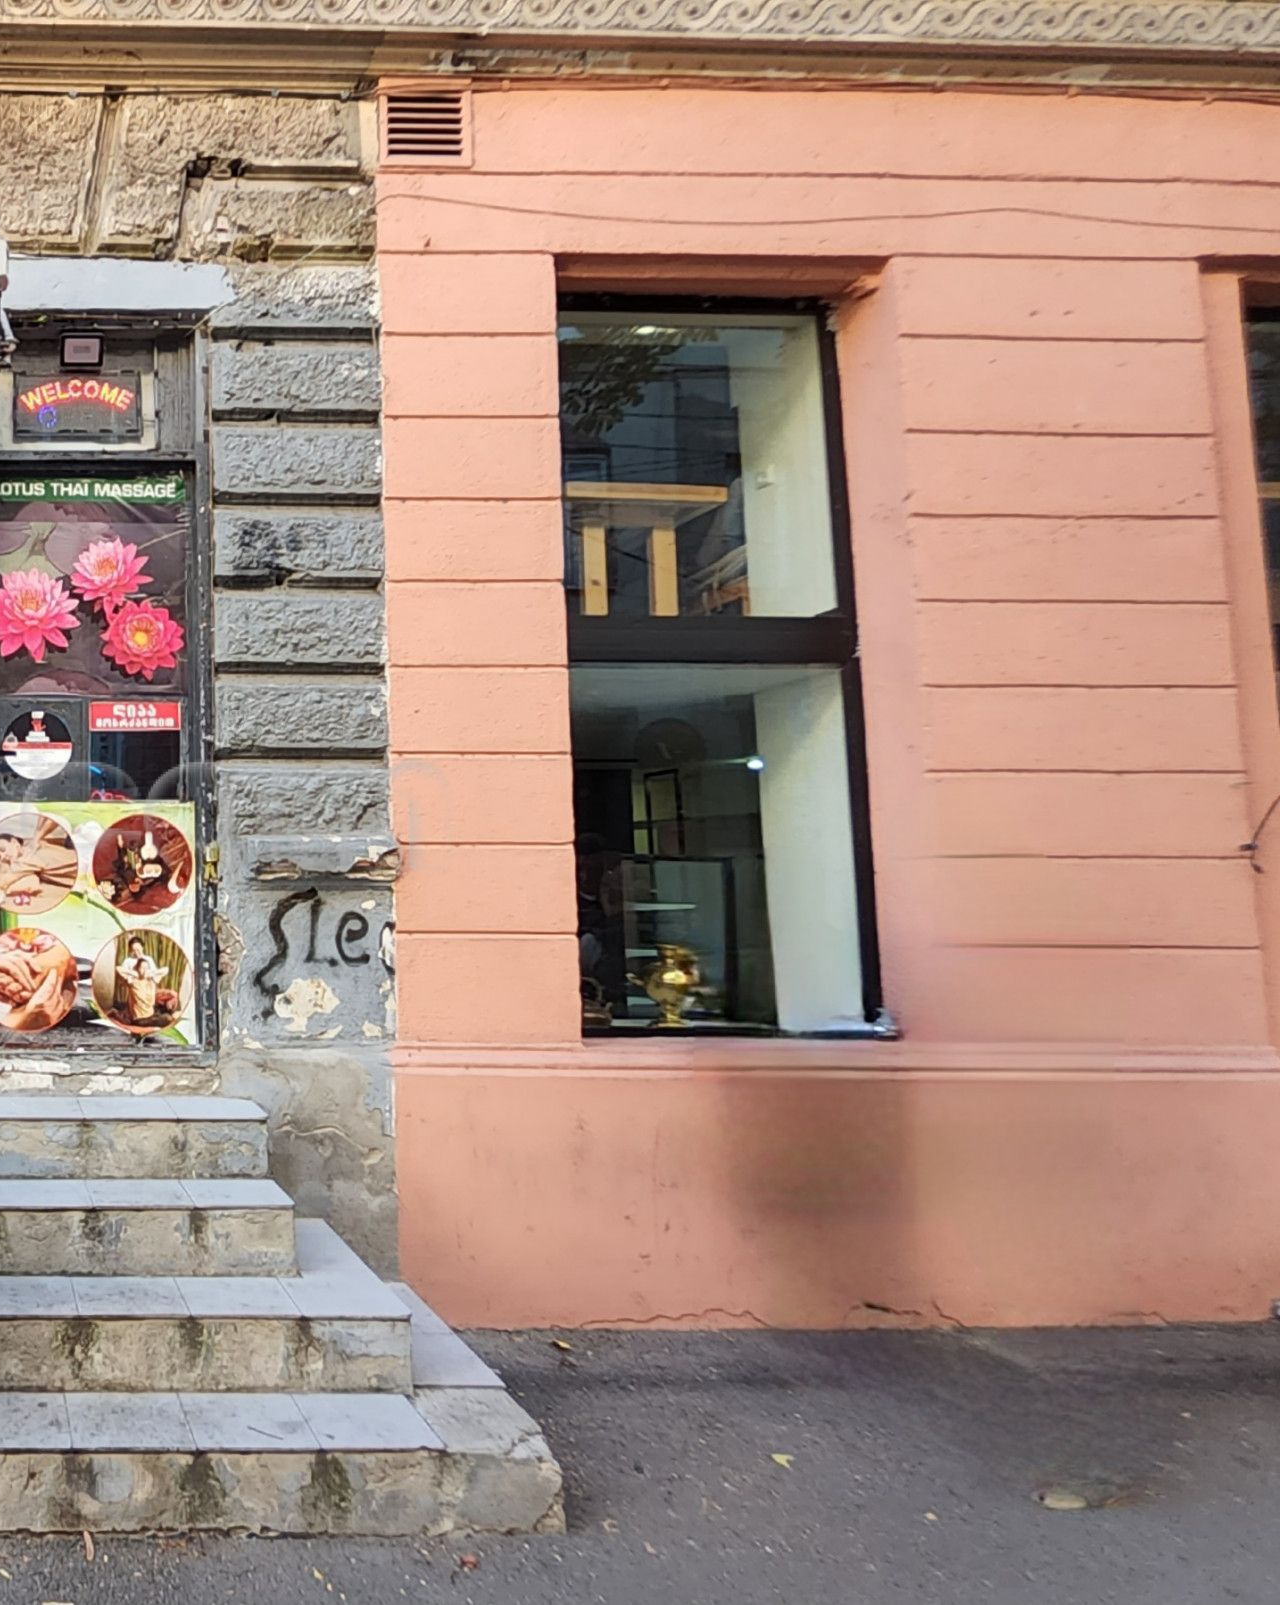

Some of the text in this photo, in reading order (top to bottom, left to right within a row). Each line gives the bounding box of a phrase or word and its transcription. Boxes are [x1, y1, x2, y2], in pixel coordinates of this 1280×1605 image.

[20, 378, 135, 412] WELCOME
[50, 482, 89, 497] THAI
[93, 482, 177, 498] MASSAGE
